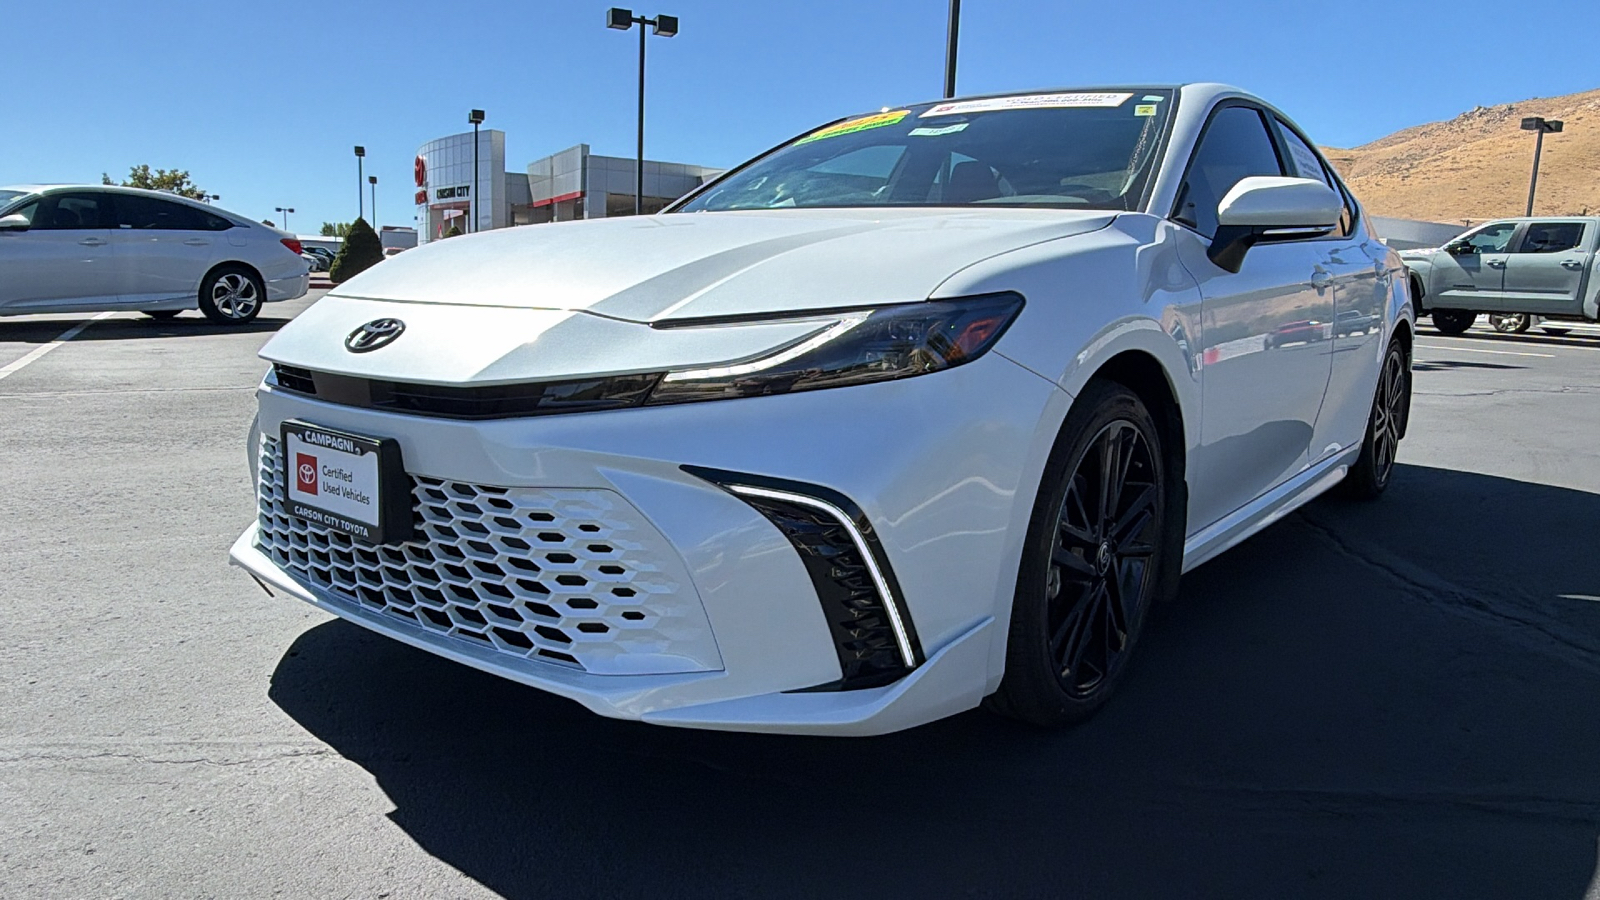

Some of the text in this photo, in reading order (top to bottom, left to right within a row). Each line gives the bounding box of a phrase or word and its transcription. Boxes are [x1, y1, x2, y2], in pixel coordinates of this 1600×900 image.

[456, 185, 471, 197] CITY
[305, 431, 353, 453] CAMPAGNI
[322, 465, 353, 483] Certified
[322, 481, 370, 505] Used Vehicles
[294, 505, 369, 537] CARSON CITY TOYOTA
